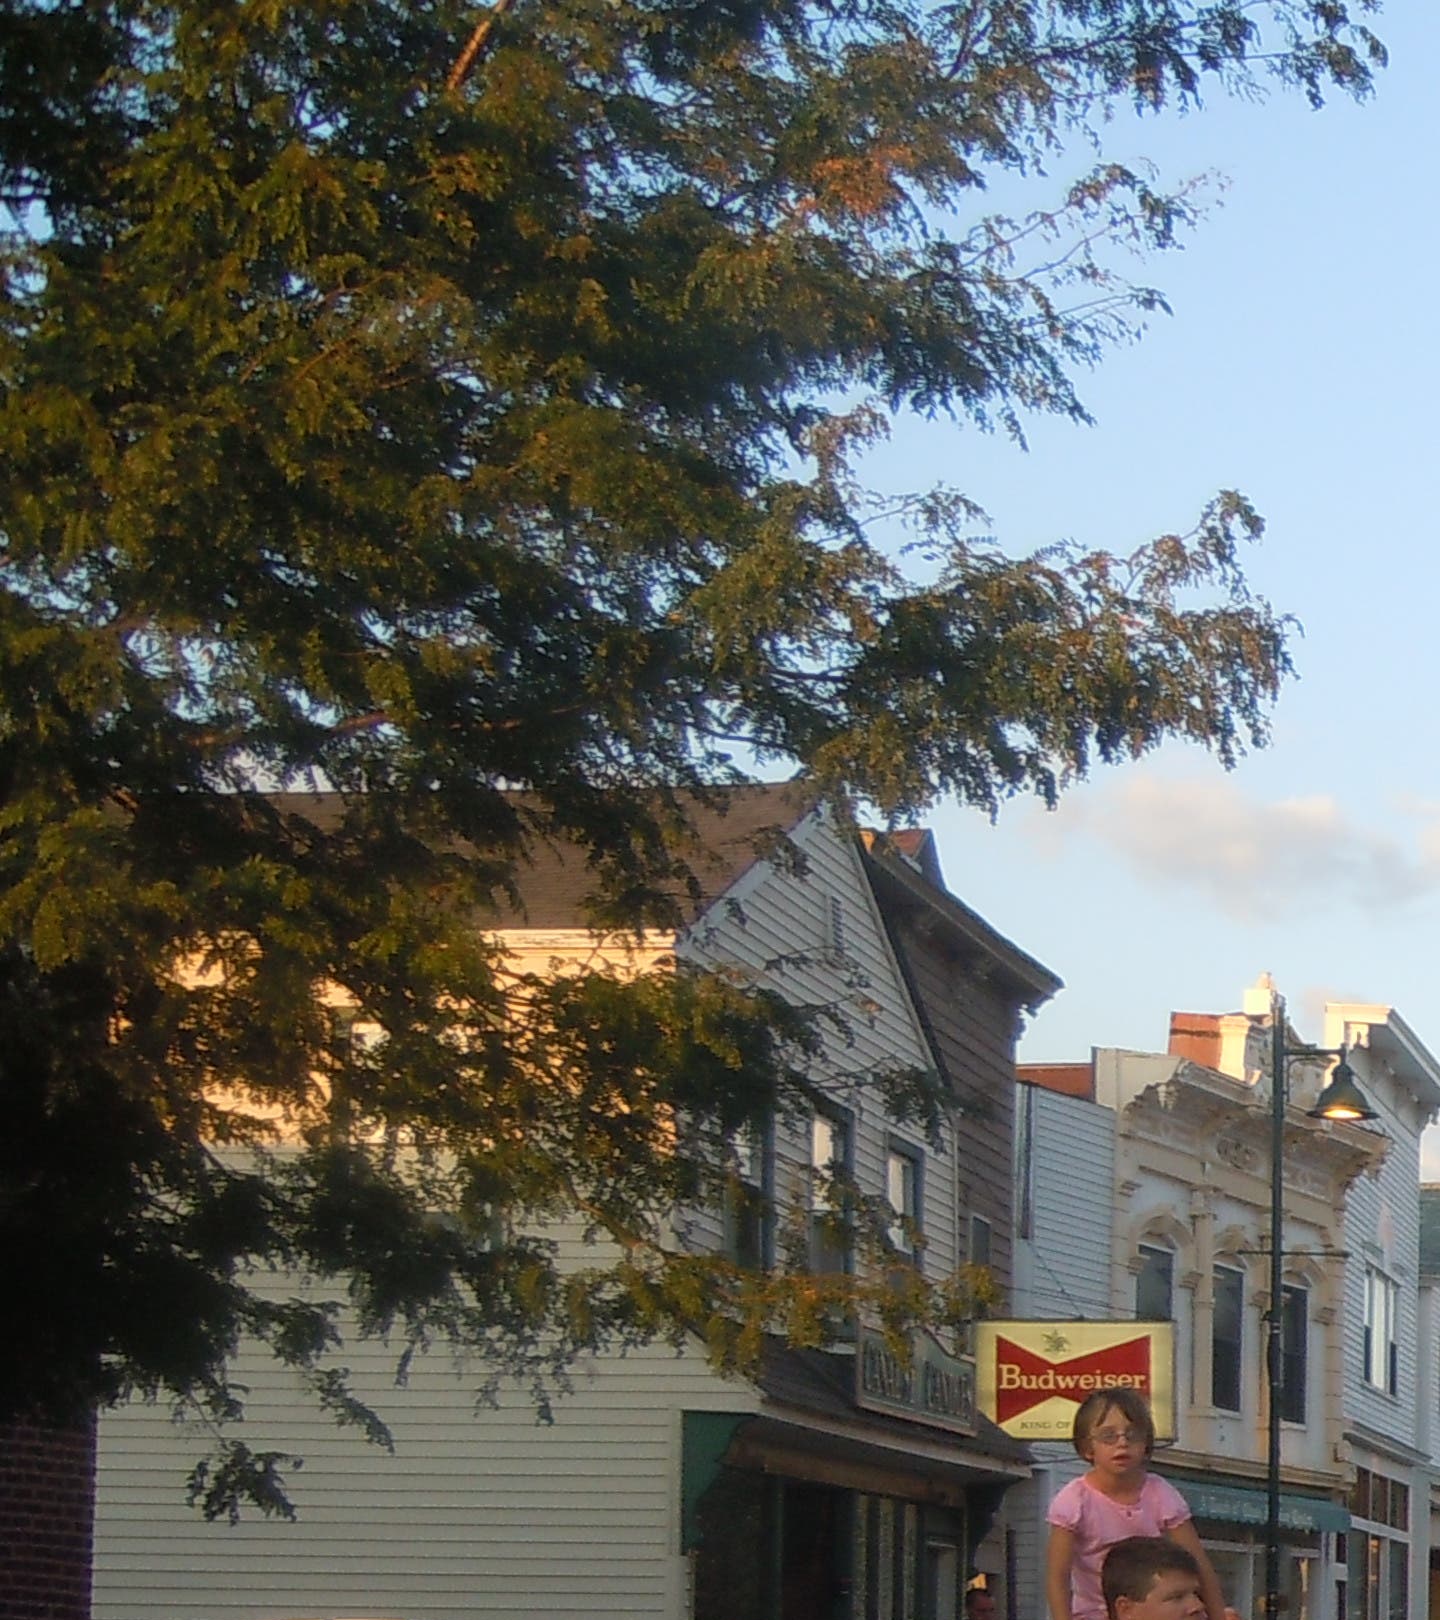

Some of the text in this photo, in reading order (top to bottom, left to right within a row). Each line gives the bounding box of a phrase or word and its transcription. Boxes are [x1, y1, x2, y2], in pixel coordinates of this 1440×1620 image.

[998, 1363, 1147, 1390] Budweiser
[1020, 1420, 1072, 1430] KING OF
